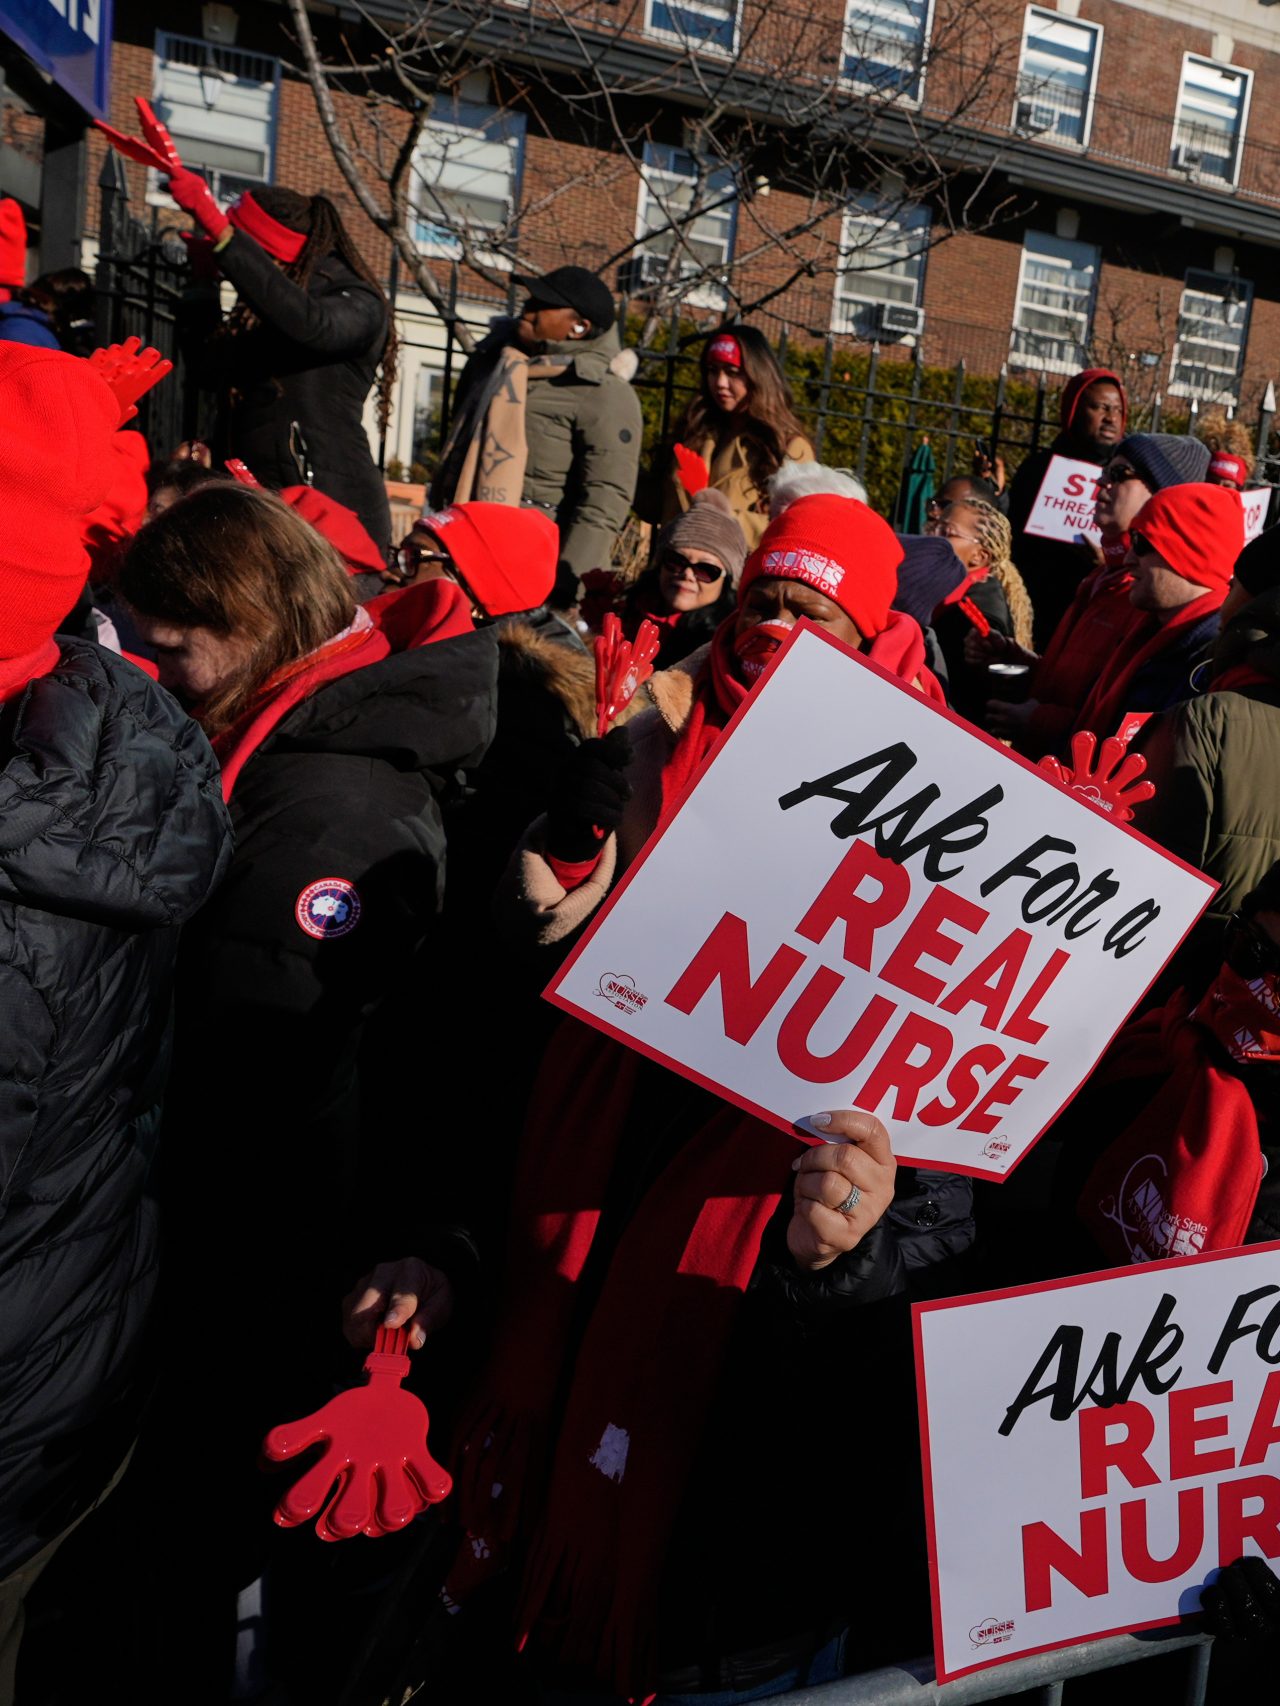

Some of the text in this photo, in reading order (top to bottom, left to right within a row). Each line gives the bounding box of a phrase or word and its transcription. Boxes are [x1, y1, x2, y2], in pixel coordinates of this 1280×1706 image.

[778, 741, 1161, 960] Ask For a
[795, 838, 1072, 1045] REAL
[664, 911, 1050, 1135] NURSE
[997, 1293, 1185, 1437] Ask
